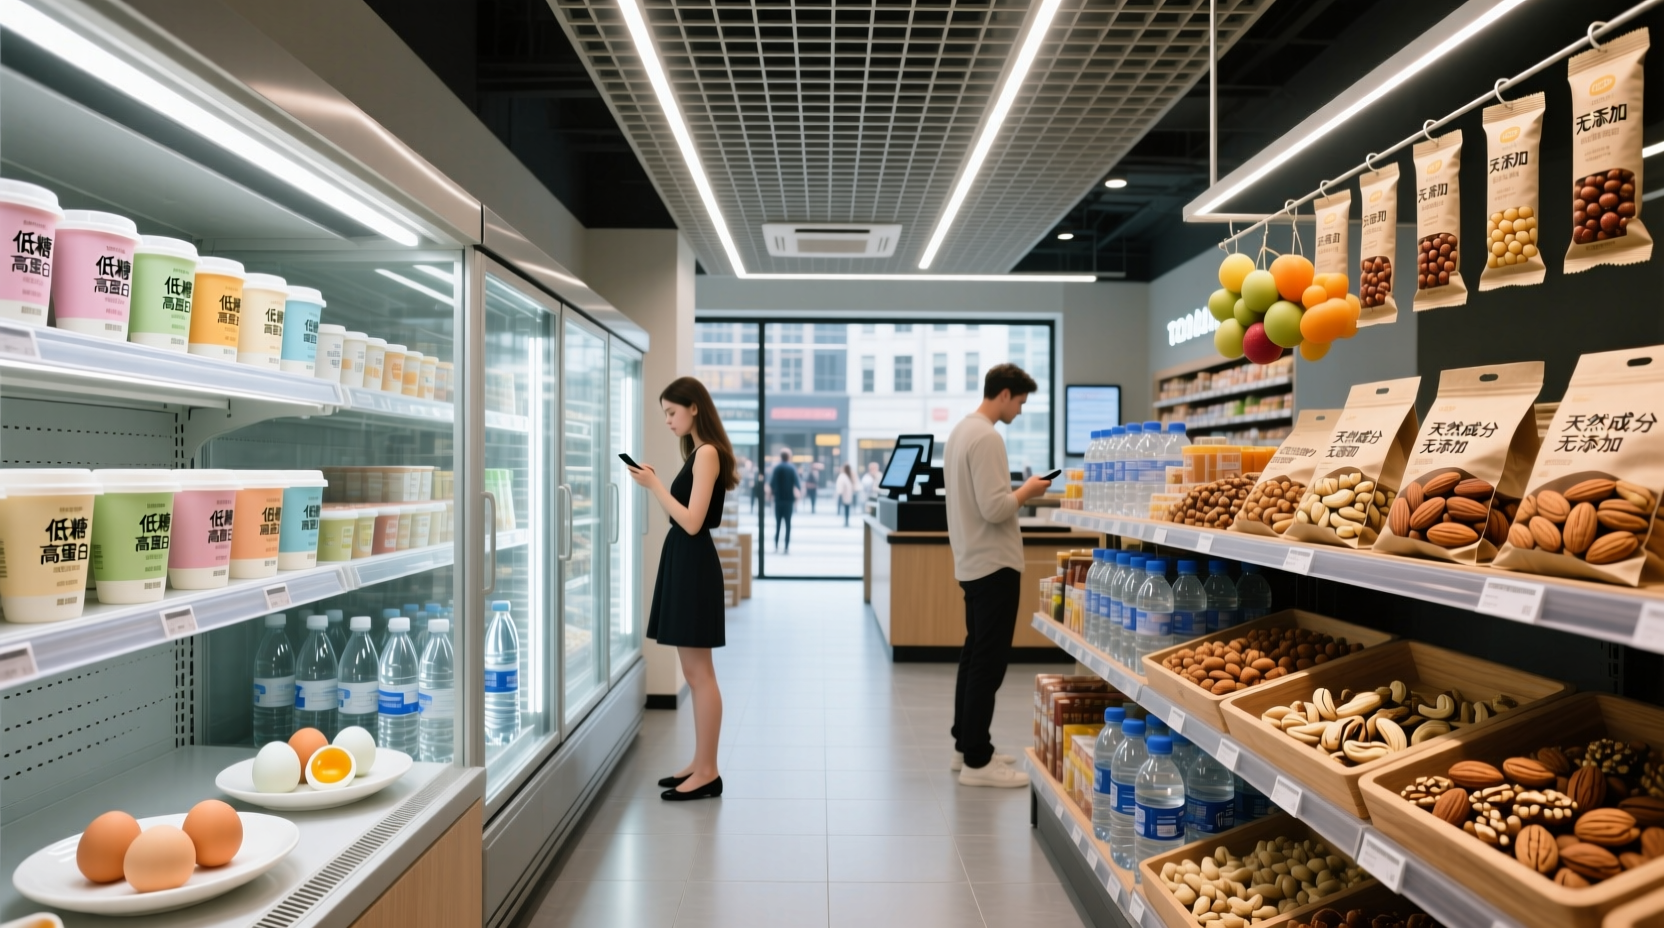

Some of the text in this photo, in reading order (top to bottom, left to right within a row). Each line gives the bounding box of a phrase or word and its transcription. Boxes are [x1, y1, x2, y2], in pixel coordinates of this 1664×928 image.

[1576, 104, 1628, 135] 无添加
[12, 230, 53, 258] 低糖
[95, 255, 131, 280] 低糖
[1427, 421, 1499, 438] 天然成分
[1561, 411, 1658, 433] 天然成分
[1419, 439, 1468, 454] 无添加
[1554, 435, 1624, 453] 无添加
[45, 516, 88, 542] 低糖
[139, 512, 171, 533] 低糖
[39, 543, 88, 565] 高蛋白
